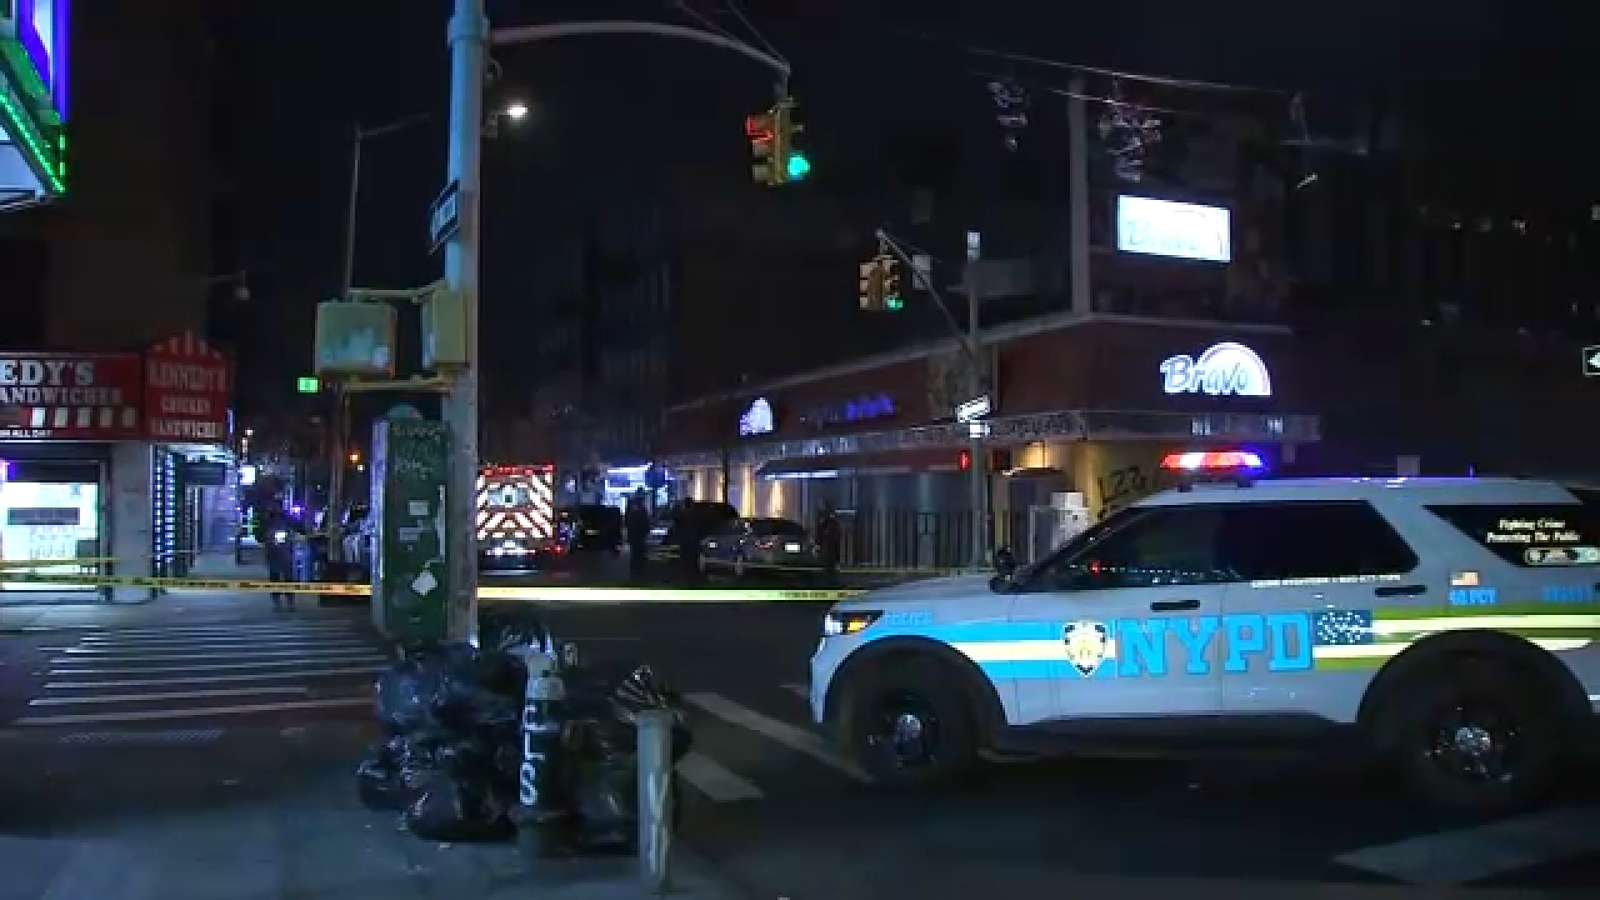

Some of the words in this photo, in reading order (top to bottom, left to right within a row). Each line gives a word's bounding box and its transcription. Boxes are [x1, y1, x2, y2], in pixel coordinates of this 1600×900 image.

[0, 359, 94, 386] EDY'S
[1161, 354, 1248, 395] Bravo
[1116, 611, 1313, 678] NYPD
